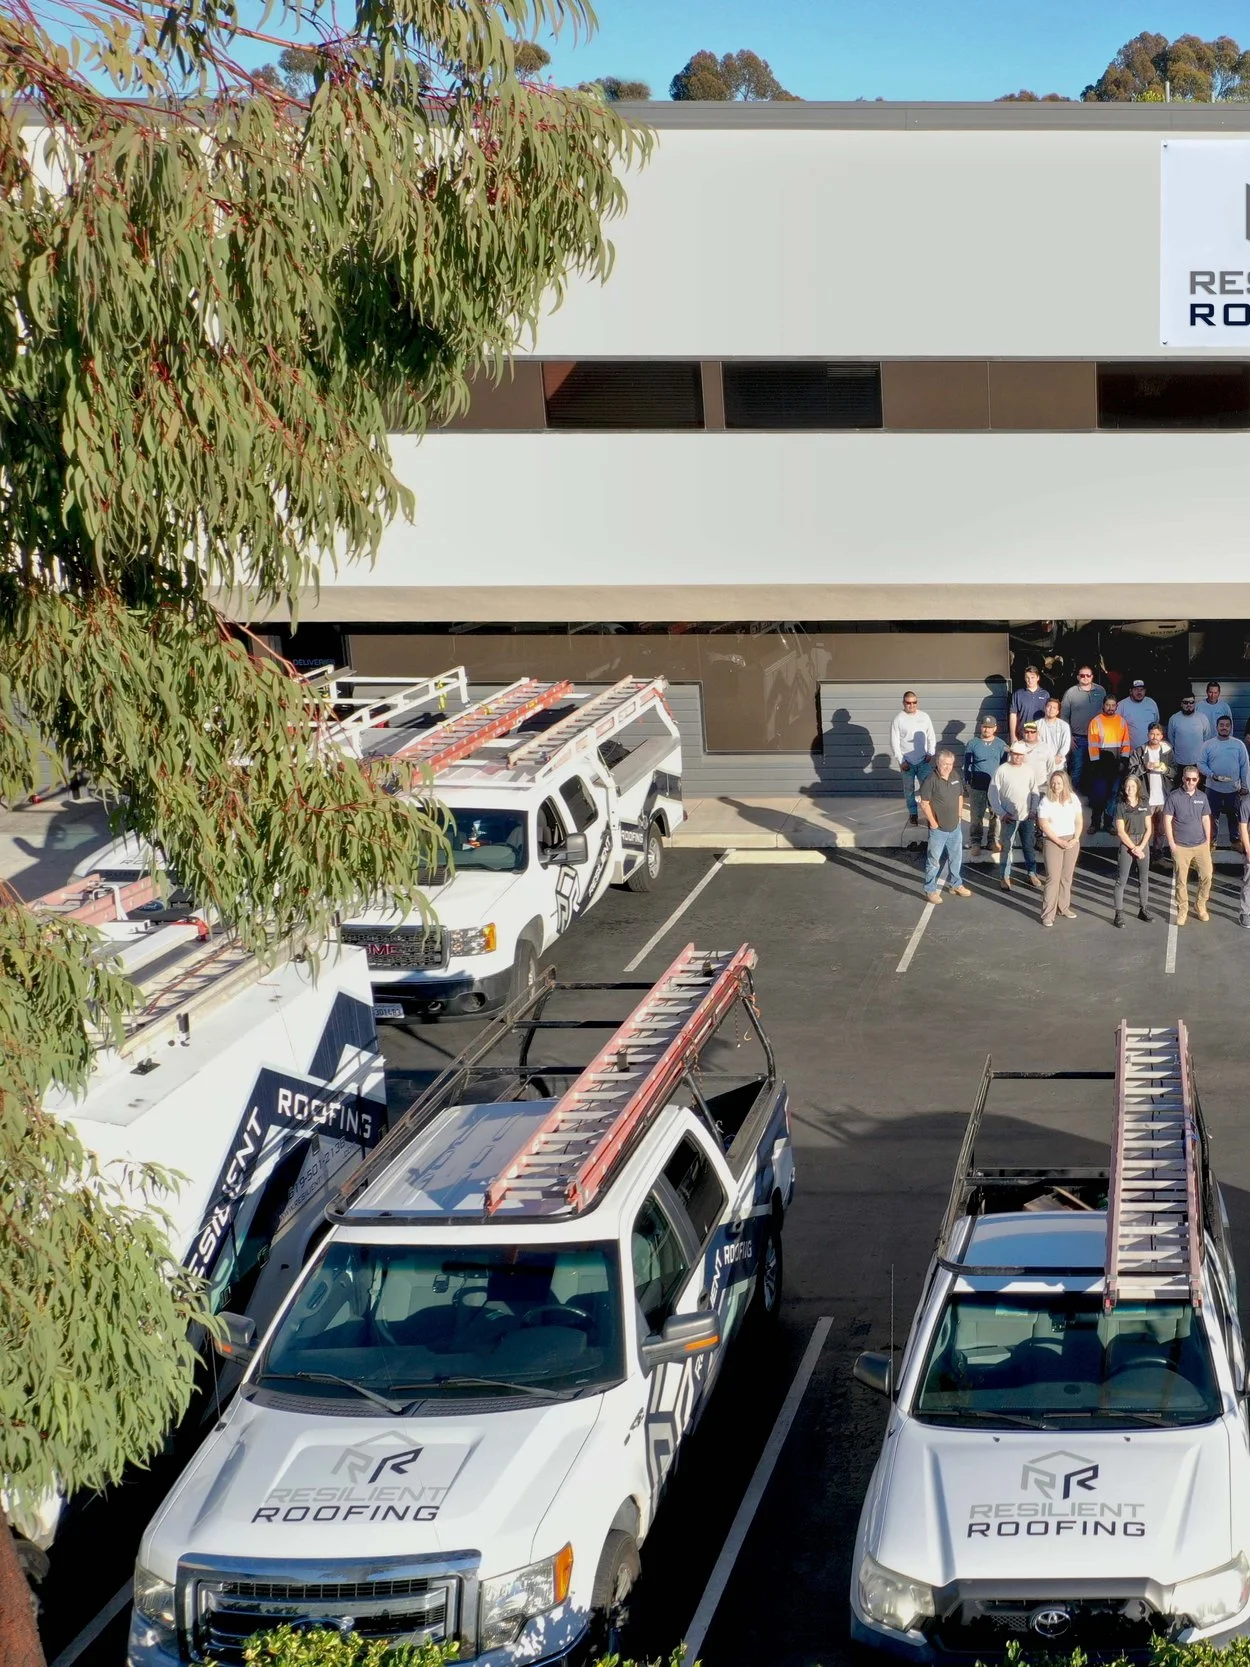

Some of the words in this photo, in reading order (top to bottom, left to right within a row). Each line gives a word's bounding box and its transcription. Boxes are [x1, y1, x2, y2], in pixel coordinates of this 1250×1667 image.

[265, 1486, 449, 1503] RESILIENT
[251, 1505, 441, 1523] ROOFING
[969, 1502, 1145, 1519] RESILIENT
[967, 1520, 1146, 1538] ROOFING
